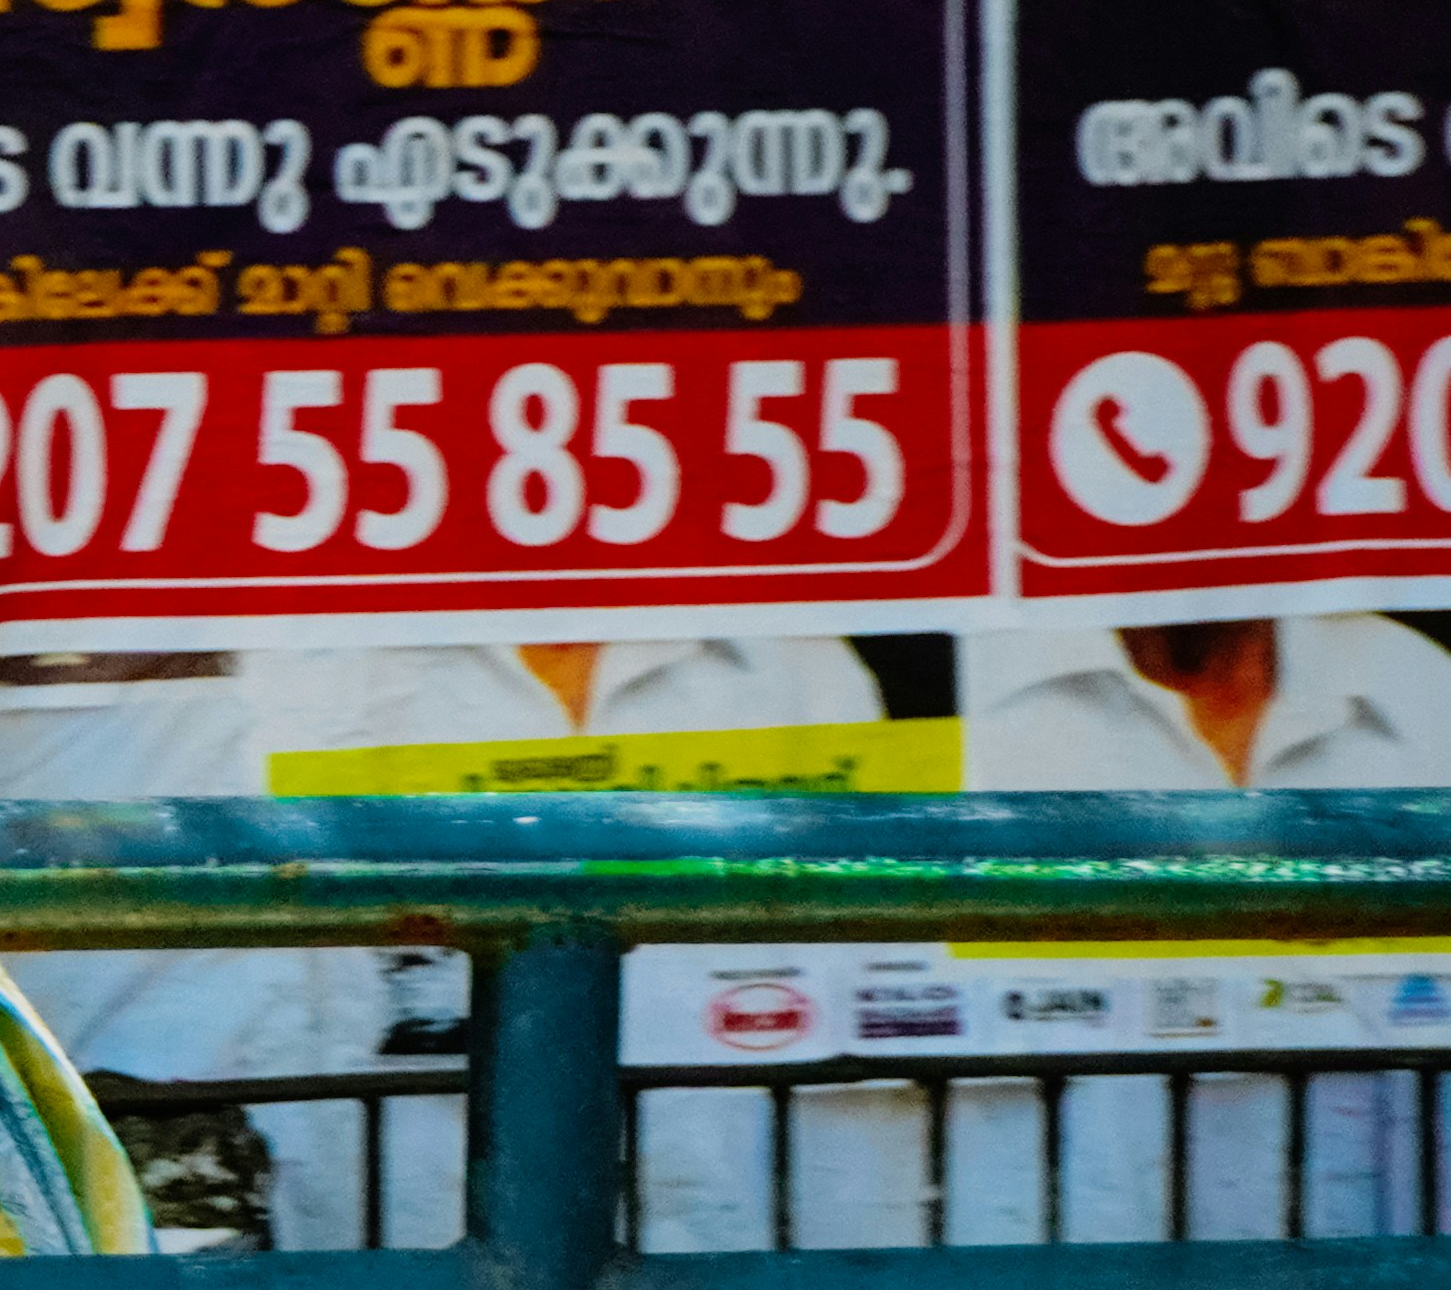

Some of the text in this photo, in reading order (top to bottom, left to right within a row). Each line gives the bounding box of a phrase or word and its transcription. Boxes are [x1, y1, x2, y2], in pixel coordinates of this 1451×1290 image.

[50, 119, 311, 233] വന്നു
[334, 108, 913, 231] എടുക്കുന്നു.
[1076, 67, 1426, 187] അവിടെ
[252, 368, 448, 555] 55
[487, 358, 681, 547] 85
[720, 357, 905, 539] 55
